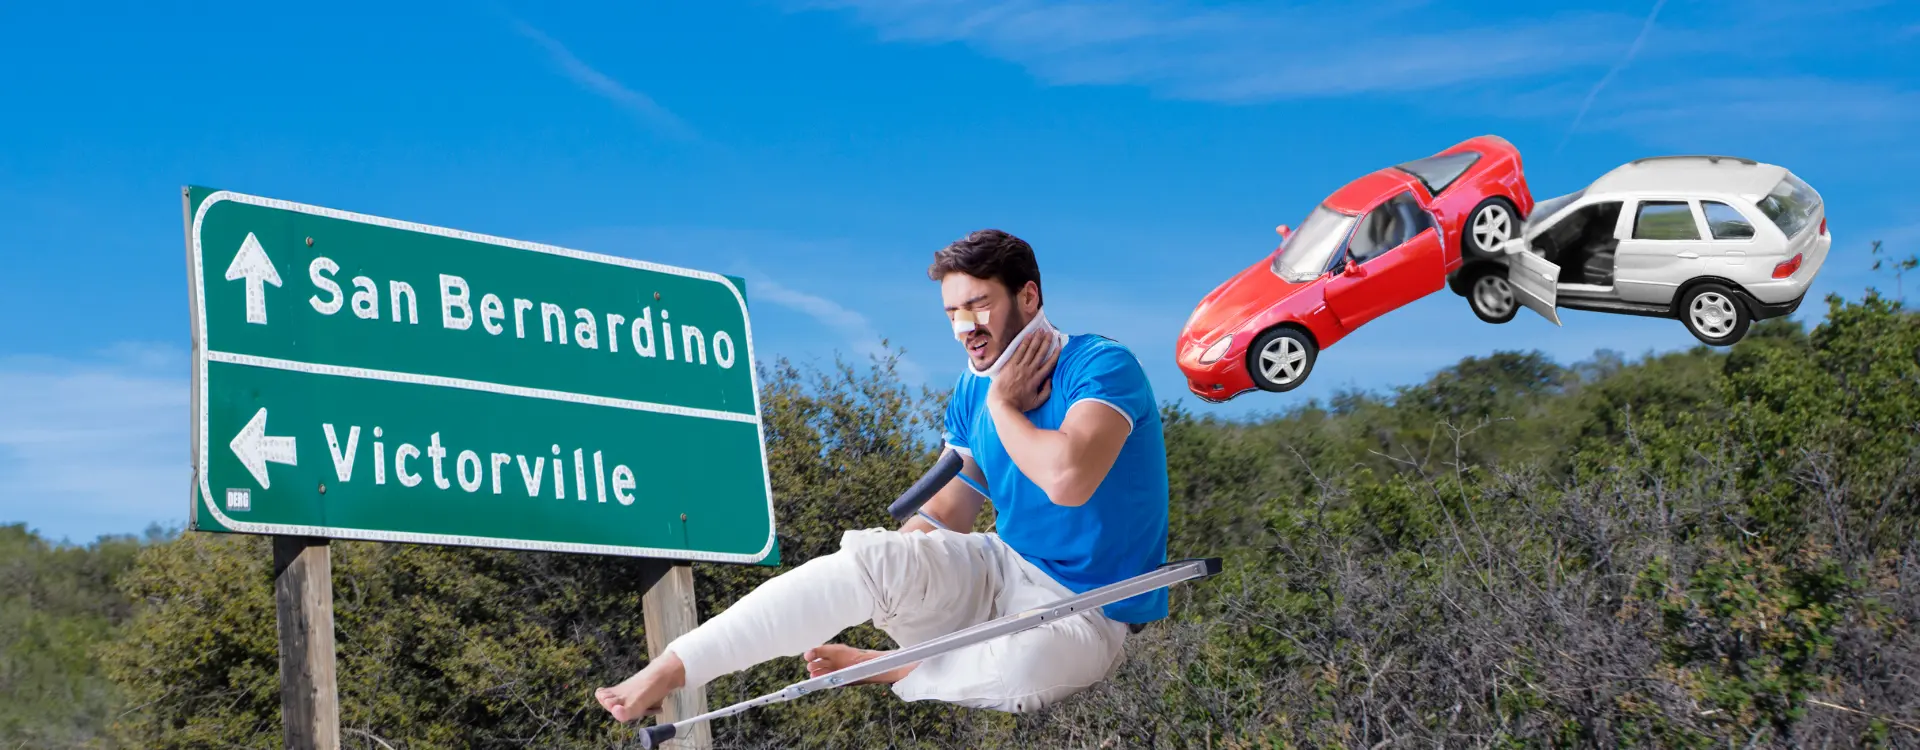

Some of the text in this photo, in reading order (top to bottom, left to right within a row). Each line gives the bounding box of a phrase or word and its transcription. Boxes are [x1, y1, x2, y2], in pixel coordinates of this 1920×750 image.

[308, 256, 735, 369] San Bernardino
[322, 423, 637, 506] Victorville
